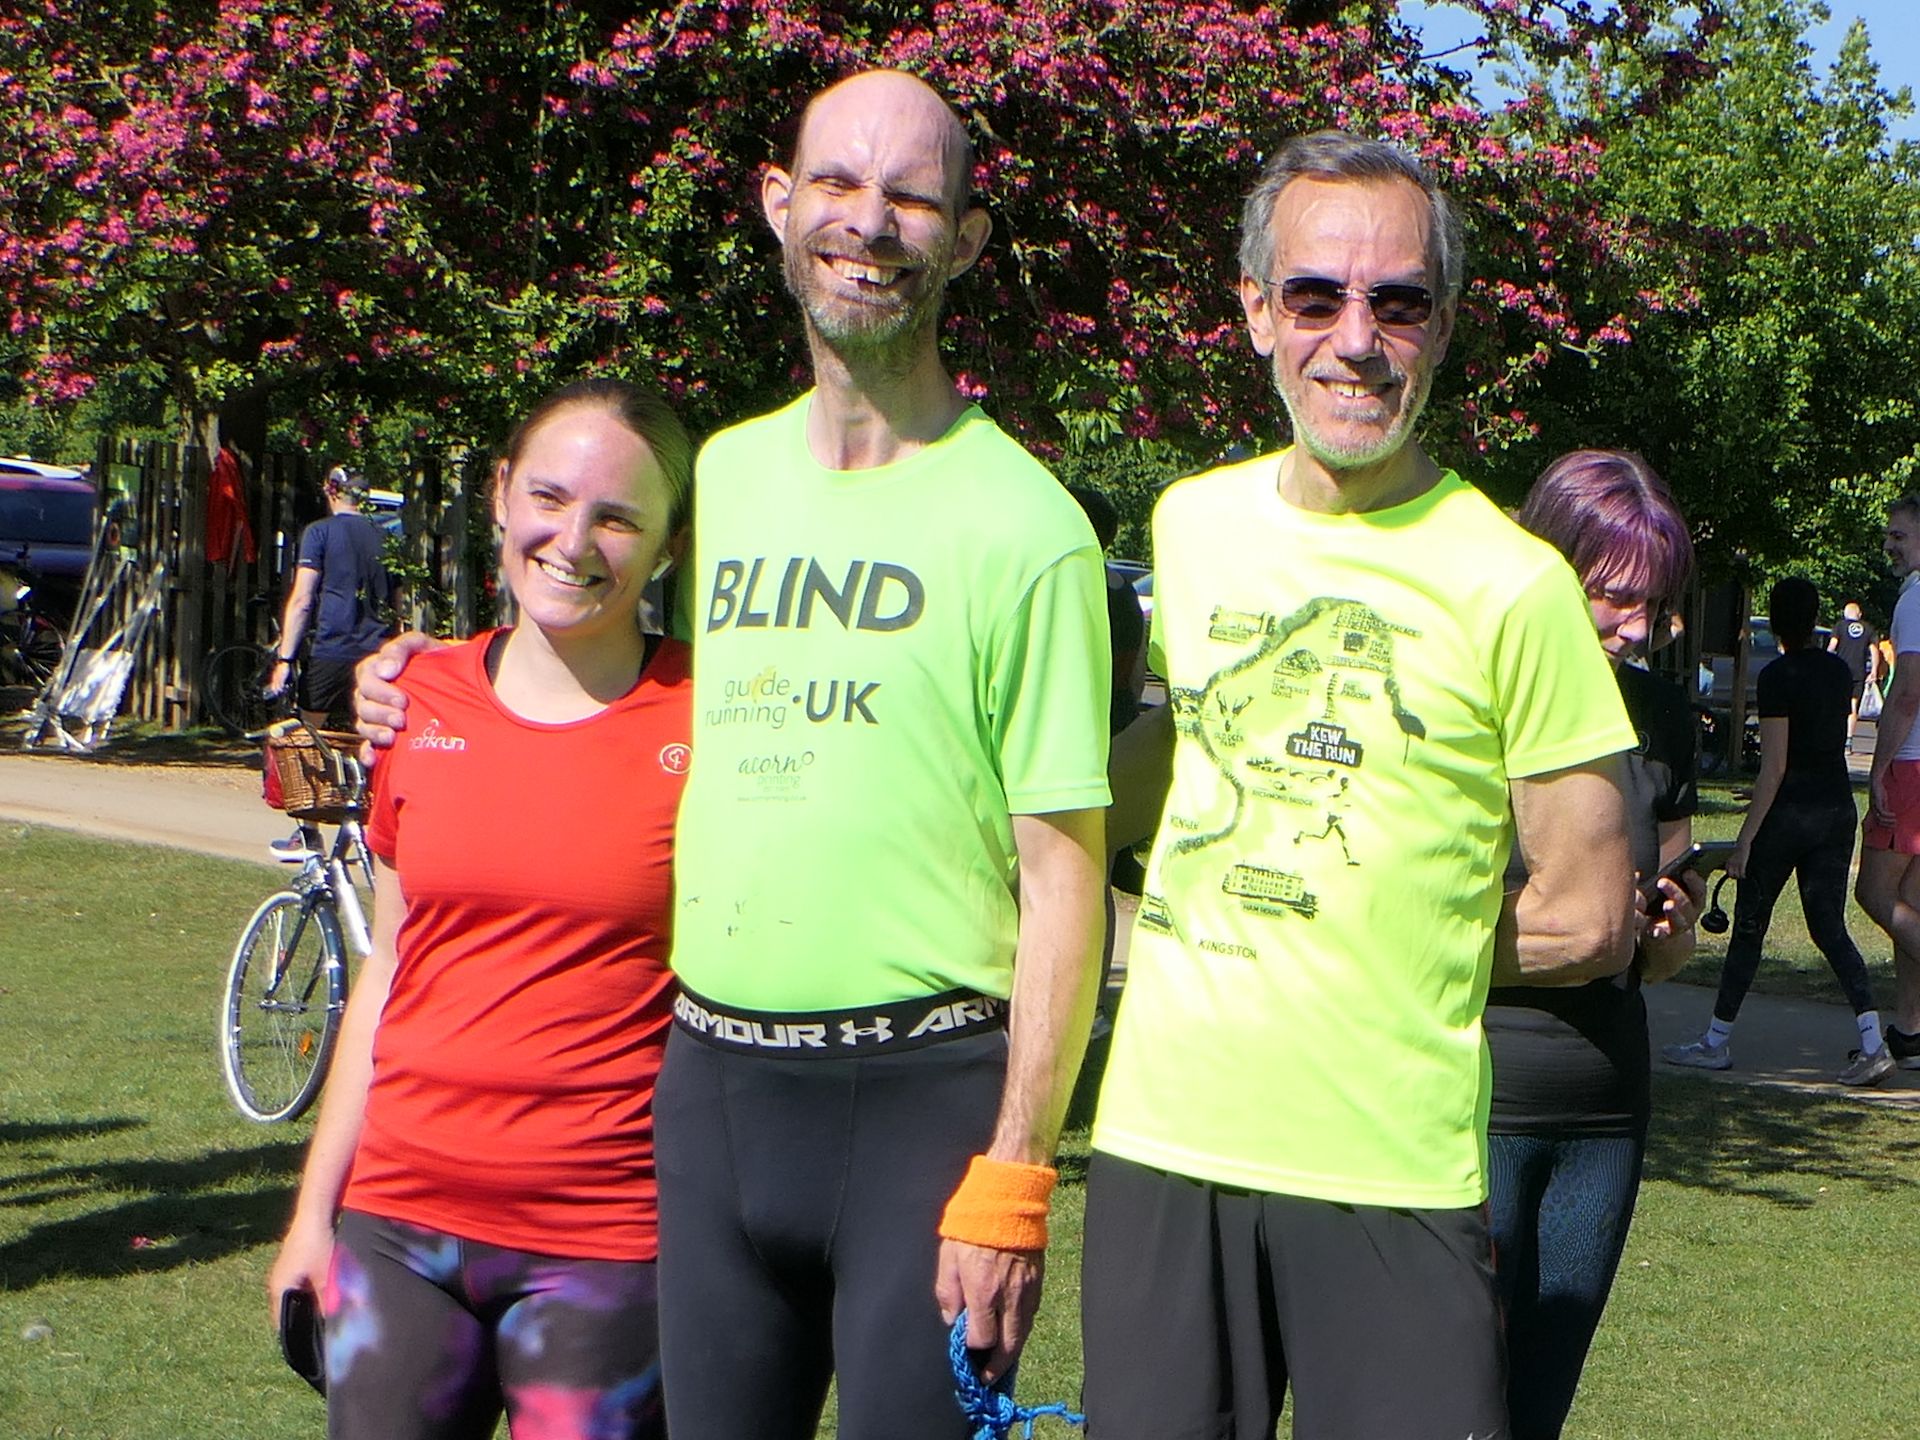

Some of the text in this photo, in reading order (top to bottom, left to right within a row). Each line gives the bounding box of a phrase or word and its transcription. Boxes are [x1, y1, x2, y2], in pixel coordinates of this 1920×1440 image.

[706, 556, 926, 633] BLIND
[724, 671, 791, 704] guide
[705, 704, 787, 730] running
[1310, 725, 1343, 746] KEW
[1293, 740, 1356, 765] THE RUN
[1198, 938, 1258, 960] KINGSTON
